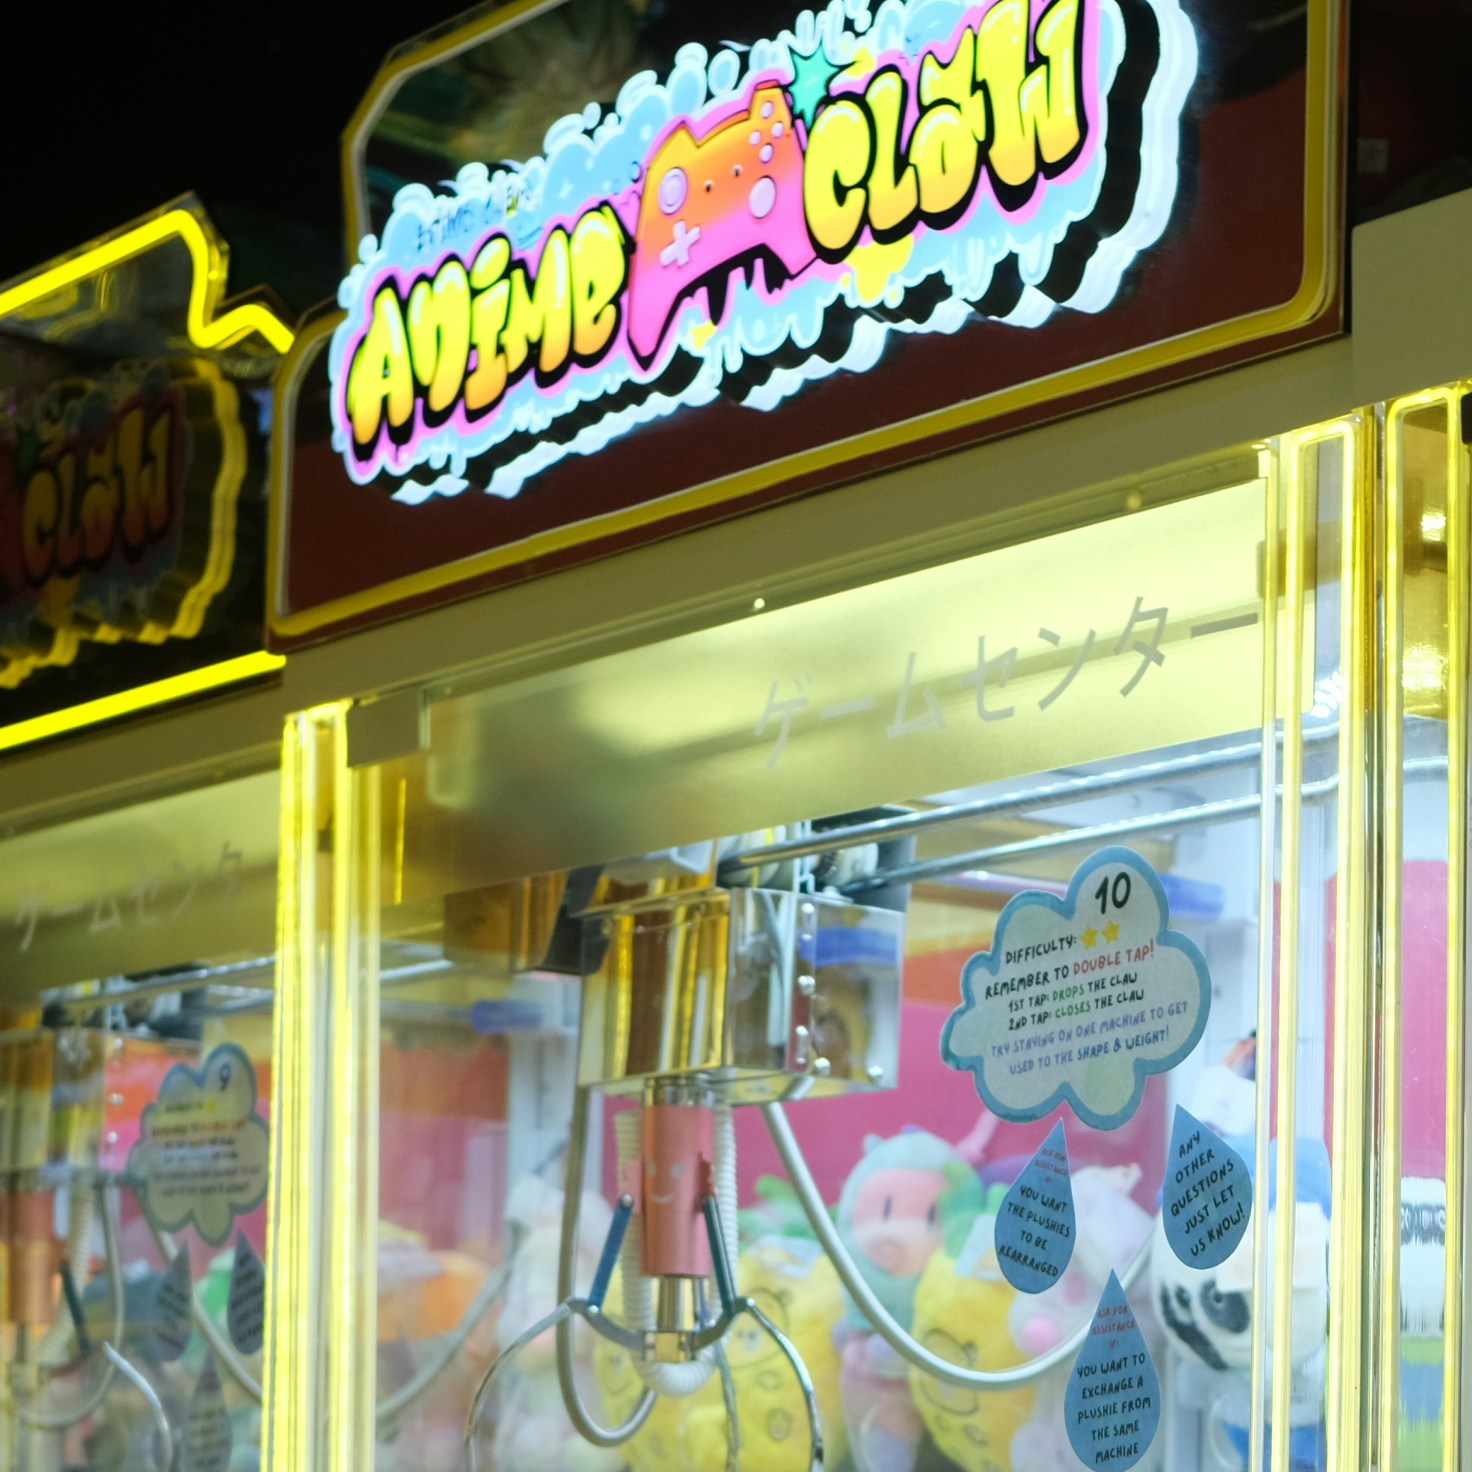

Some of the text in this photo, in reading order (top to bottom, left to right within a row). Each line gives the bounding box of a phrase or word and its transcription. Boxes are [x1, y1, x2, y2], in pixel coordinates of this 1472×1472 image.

[754, 596, 1259, 770] ゲームセンター
[1094, 871, 1131, 915] 10
[1005, 934, 1077, 965] DIFFICULTY:
[985, 938, 1155, 1000] REMEMBER TO DOUBLE TAP!
[1008, 972, 1138, 1013] 1ST TAP: DROPS THE CLAW
[1008, 989, 1144, 1031] 2ND TAP: CLOSES THE CLAW
[991, 1001, 1188, 1058] TRY STAYING ON ONE MACHINE TO GET
[1009, 1060, 1034, 1075] USED
[1037, 1056, 1051, 1069] TO
[1054, 1051, 1073, 1066] THE
[1077, 1043, 1109, 1061] SHAPE
[1125, 1025, 1170, 1050] WEIGHT!
[1179, 1130, 1201, 1158] ANY
[1175, 1148, 1215, 1184] OTHER
[1020, 1184, 1068, 1212] YOU WANT
[1170, 1158, 1234, 1217] QUESTIONS
[1007, 1201, 1070, 1239] THE PLUSHIES
[1184, 1184, 1235, 1234] JUST LET
[1020, 1229, 1048, 1250] TO BE
[1190, 1201, 1245, 1257] US KNOW!
[999, 1243, 1059, 1277] REARRANGED
[1077, 1352, 1146, 1379] YOU WANT TO
[1081, 1375, 1144, 1400] EXCHANGE A
[1077, 1396, 1151, 1424] PLUSHIE FROM
[1090, 1420, 1140, 1441] THE SAME
[1095, 1442, 1140, 1464] MACHINE
